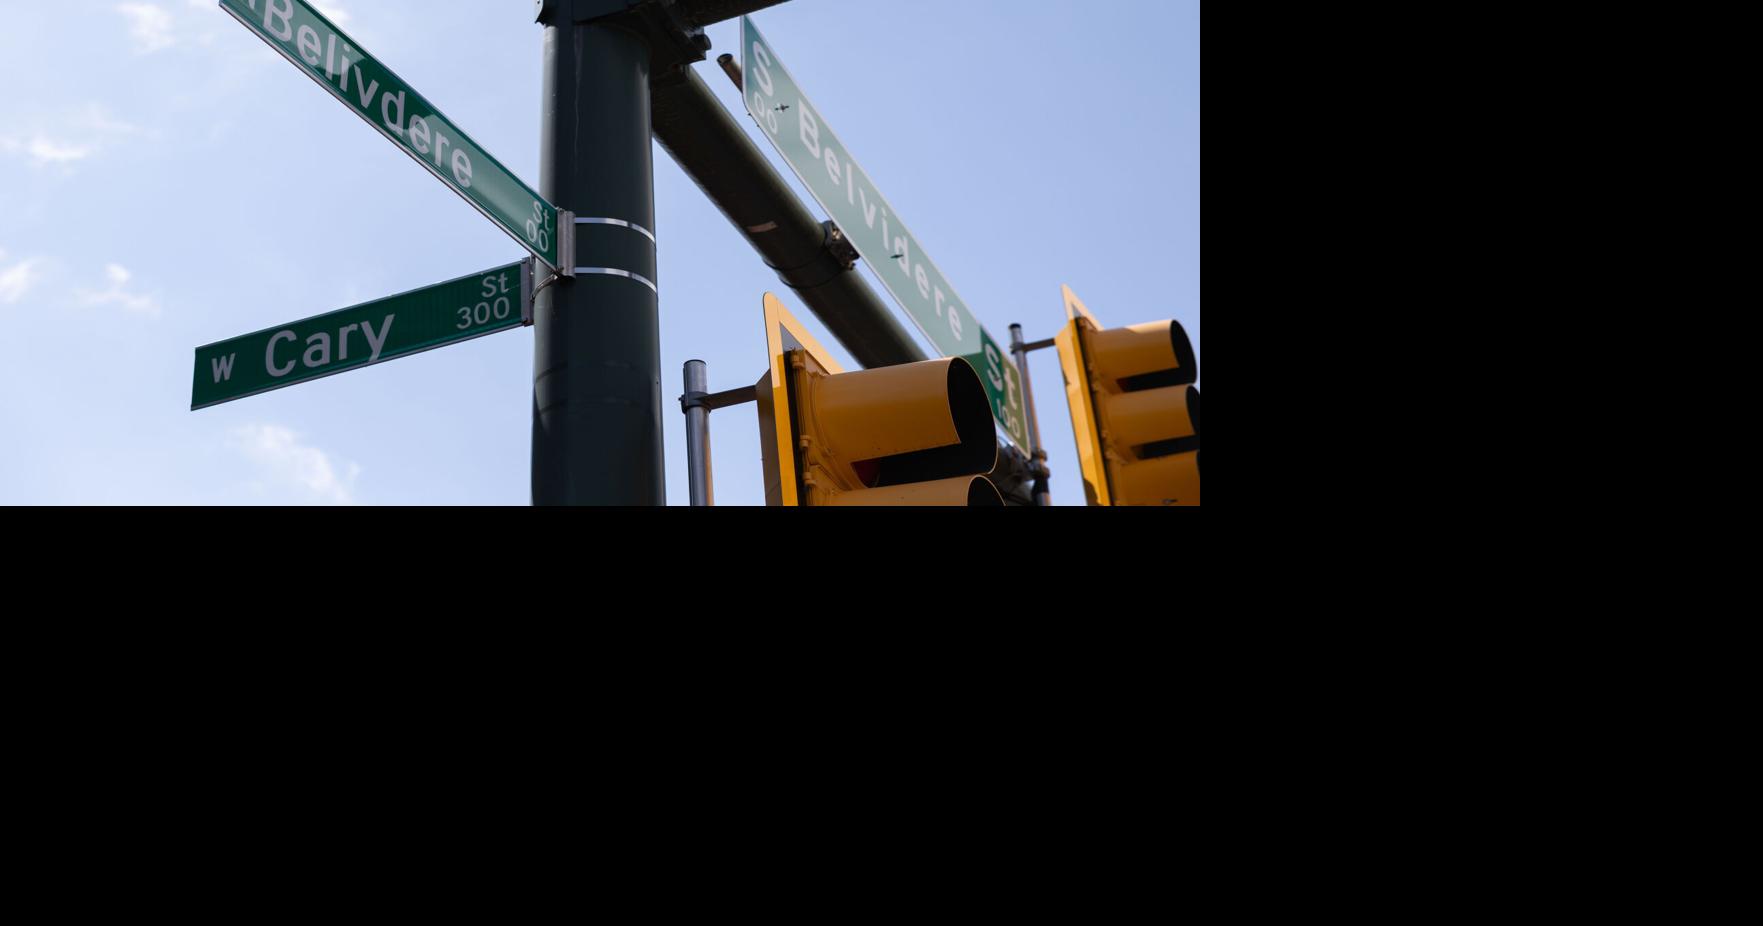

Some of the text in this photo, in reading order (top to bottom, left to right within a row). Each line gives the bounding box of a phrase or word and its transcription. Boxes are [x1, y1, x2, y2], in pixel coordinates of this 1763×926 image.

[533, 201, 549, 231] St
[752, 40, 1017, 411] S Belvidere St
[526, 219, 549, 252] 00
[211, 272, 509, 383] W Cary St
[456, 297, 510, 330] 300
[996, 398, 1021, 438] 100
